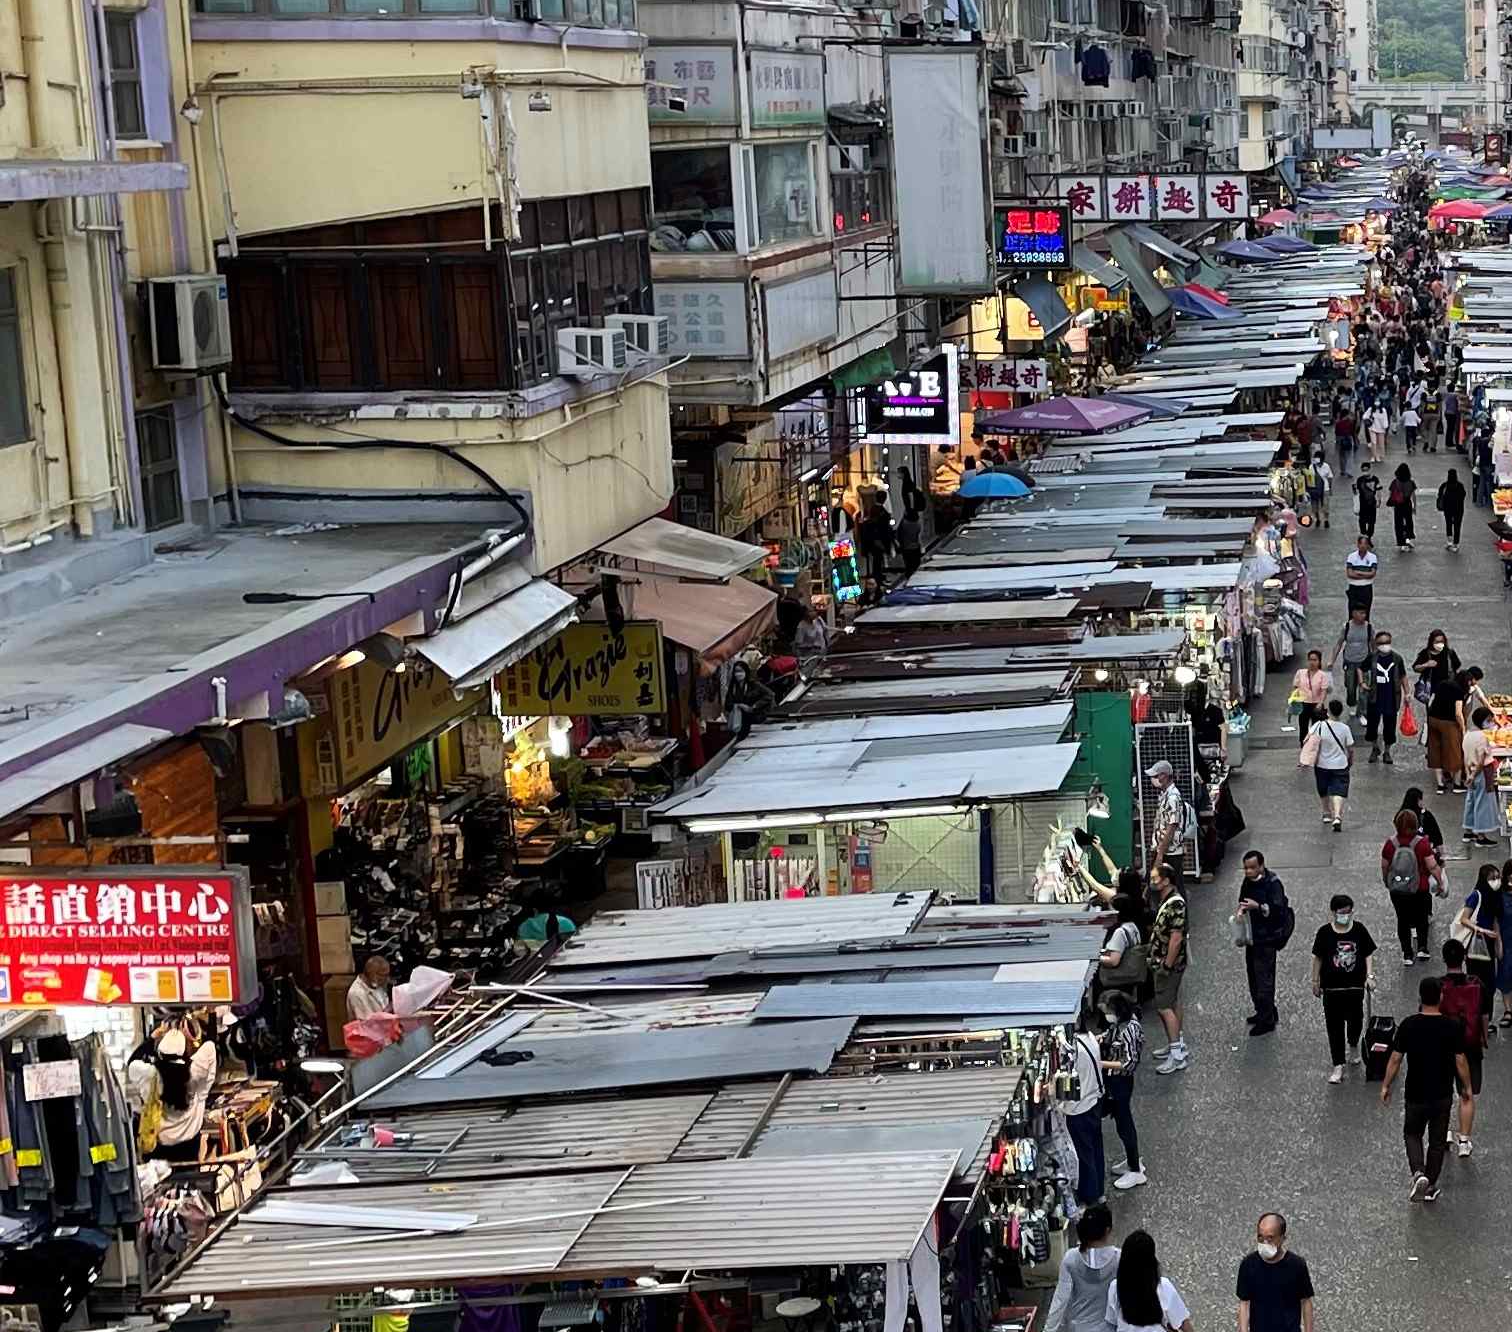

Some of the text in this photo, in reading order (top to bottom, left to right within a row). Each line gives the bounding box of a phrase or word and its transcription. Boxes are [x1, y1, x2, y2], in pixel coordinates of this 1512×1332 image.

[4, 883, 229, 924] 話直銷中心
[9, 924, 230, 938] DIRECT SELLING CENTRE
